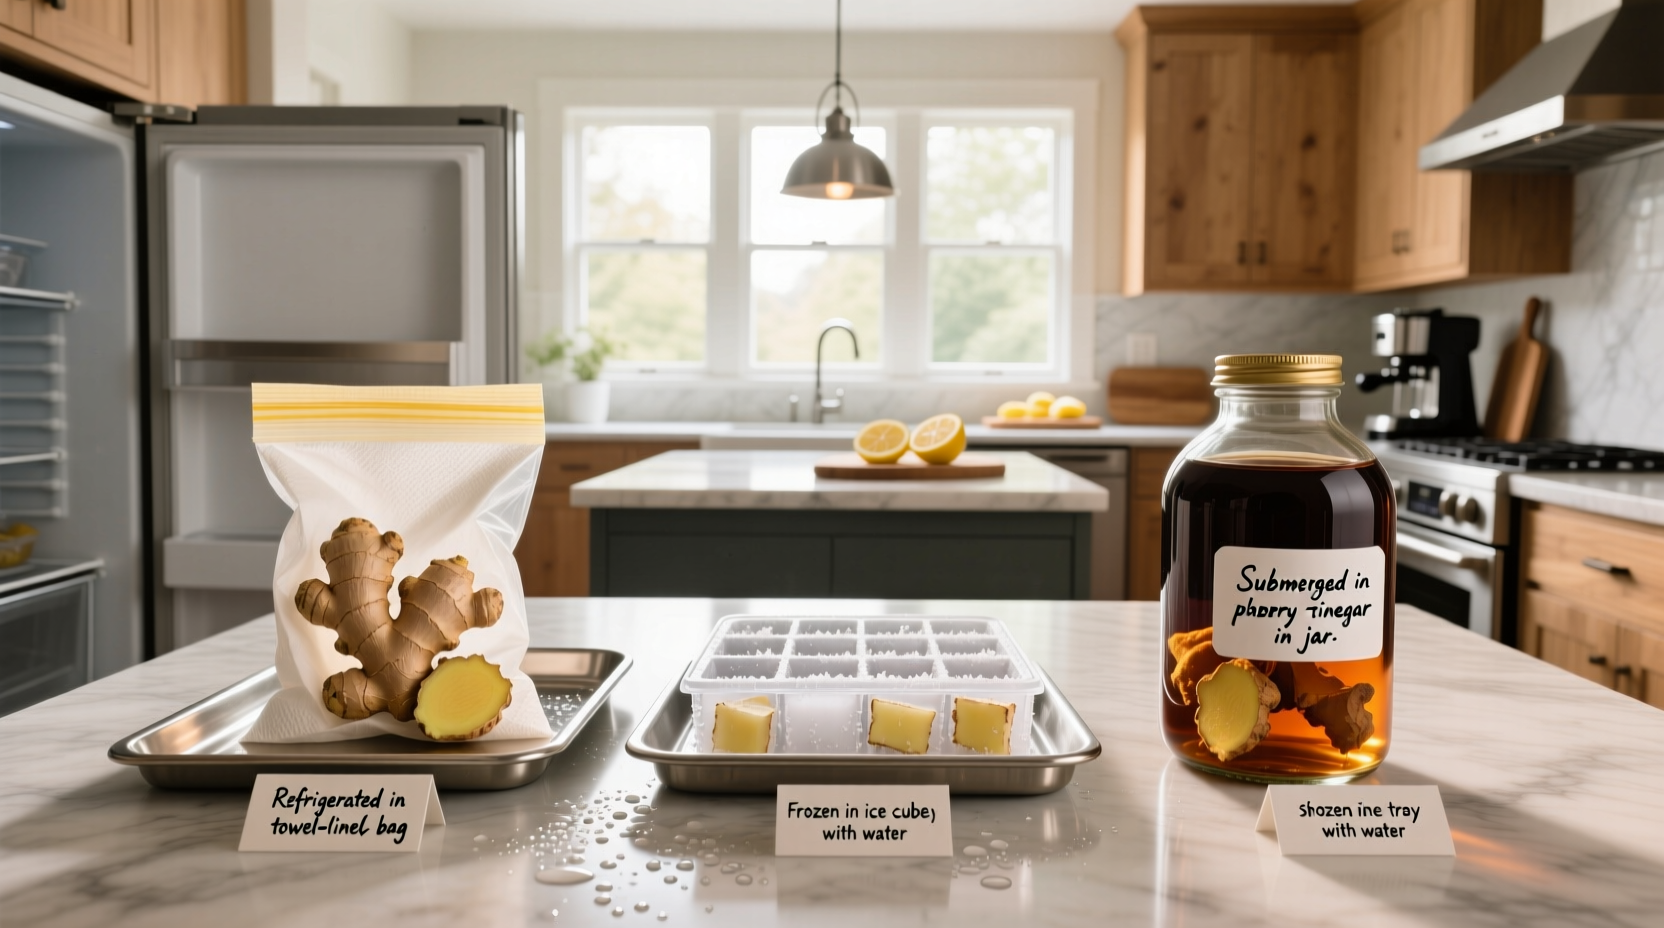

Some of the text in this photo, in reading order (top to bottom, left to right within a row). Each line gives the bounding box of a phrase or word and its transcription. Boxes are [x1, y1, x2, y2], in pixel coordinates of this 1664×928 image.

[1237, 564, 1370, 602] Submerged in
[1275, 627, 1292, 645] in
[271, 786, 406, 817] Refrigerated in
[787, 801, 840, 819] Frozen
[845, 802, 859, 819] in
[864, 802, 887, 819] ice
[1387, 801, 1421, 824] tray
[376, 814, 408, 845] bag
[822, 824, 908, 841] with water
[1321, 822, 1406, 838] with water
